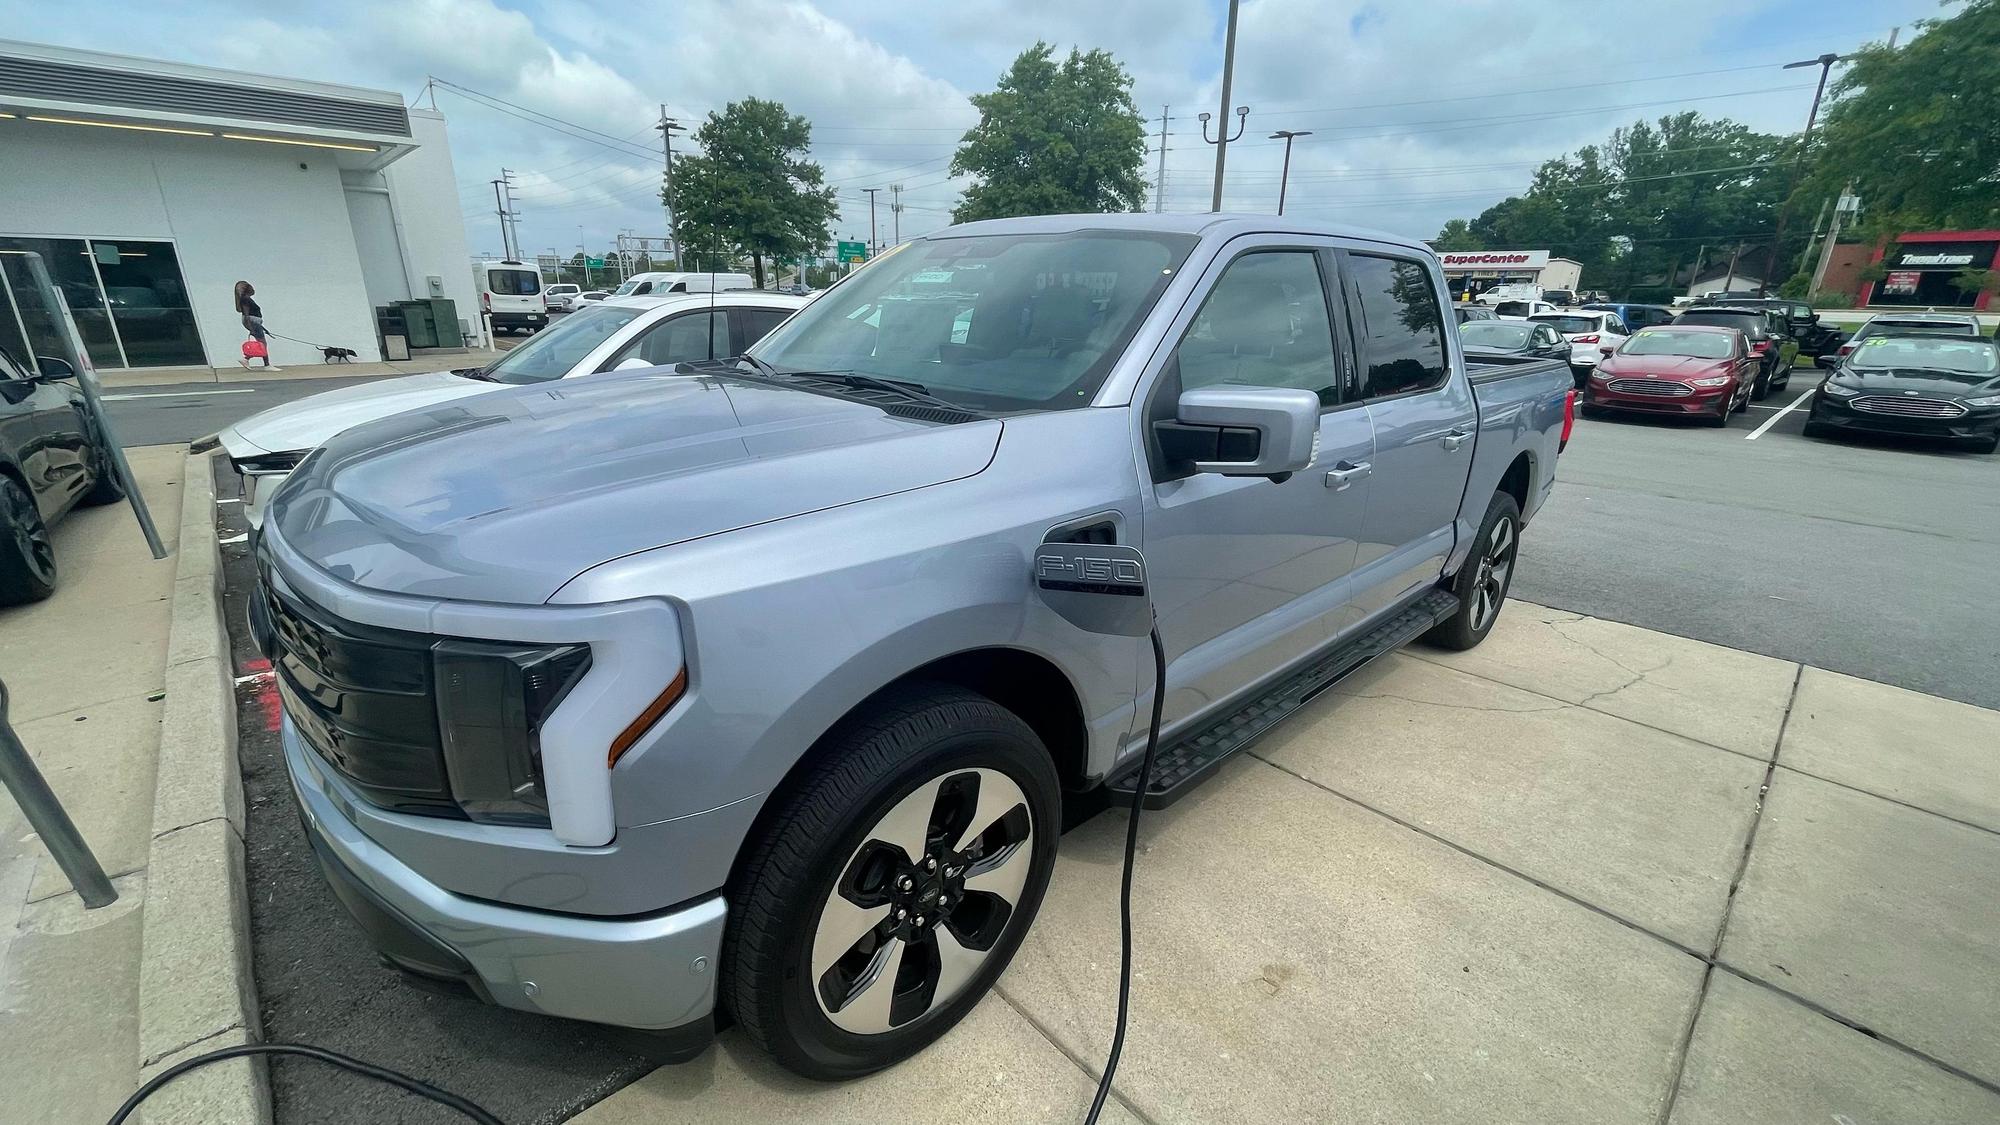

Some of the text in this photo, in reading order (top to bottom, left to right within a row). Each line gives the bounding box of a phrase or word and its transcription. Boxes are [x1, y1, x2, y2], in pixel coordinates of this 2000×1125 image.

[1443, 254, 1529, 265] SuperCenter
[1865, 336, 1888, 346] 20
[1037, 554, 1143, 583] F-150
